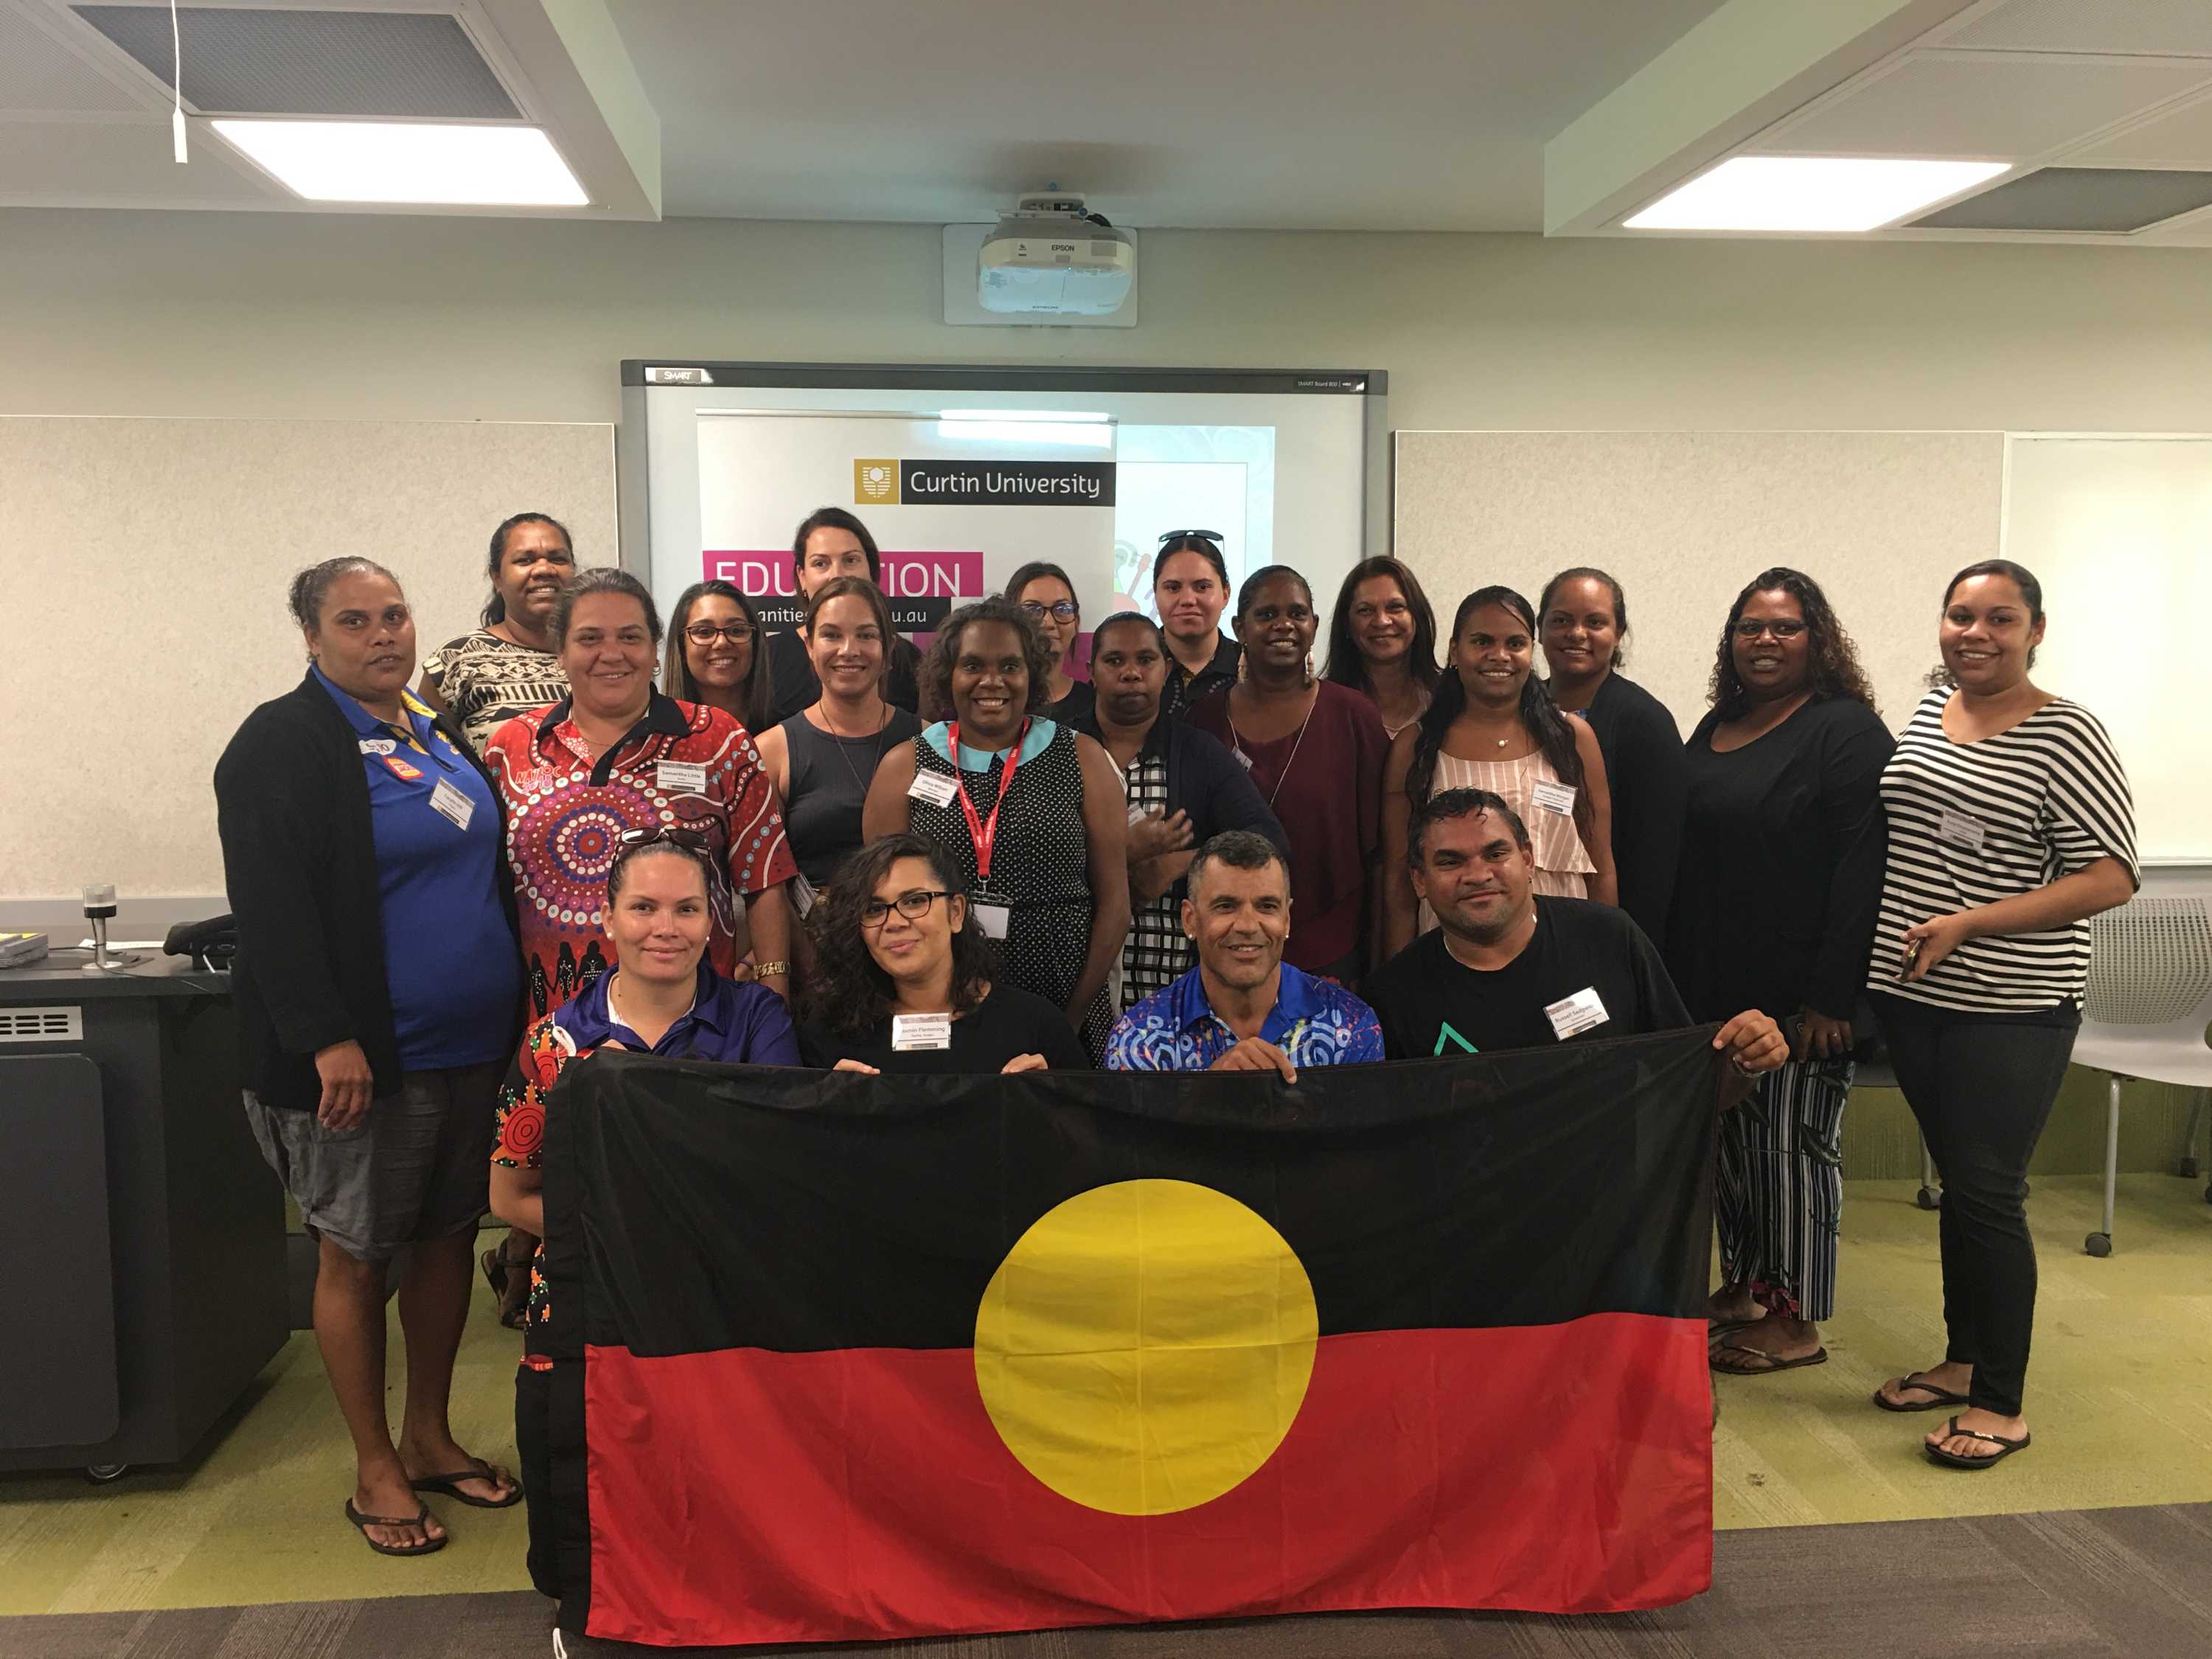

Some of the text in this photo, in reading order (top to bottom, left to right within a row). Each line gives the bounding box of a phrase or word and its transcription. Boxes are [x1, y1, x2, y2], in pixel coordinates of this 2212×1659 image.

[1051, 244, 1075, 252] EPSON
[664, 371, 692, 380] SMART
[911, 471, 1100, 498] Curtin University
[717, 561, 960, 598] EDUION
